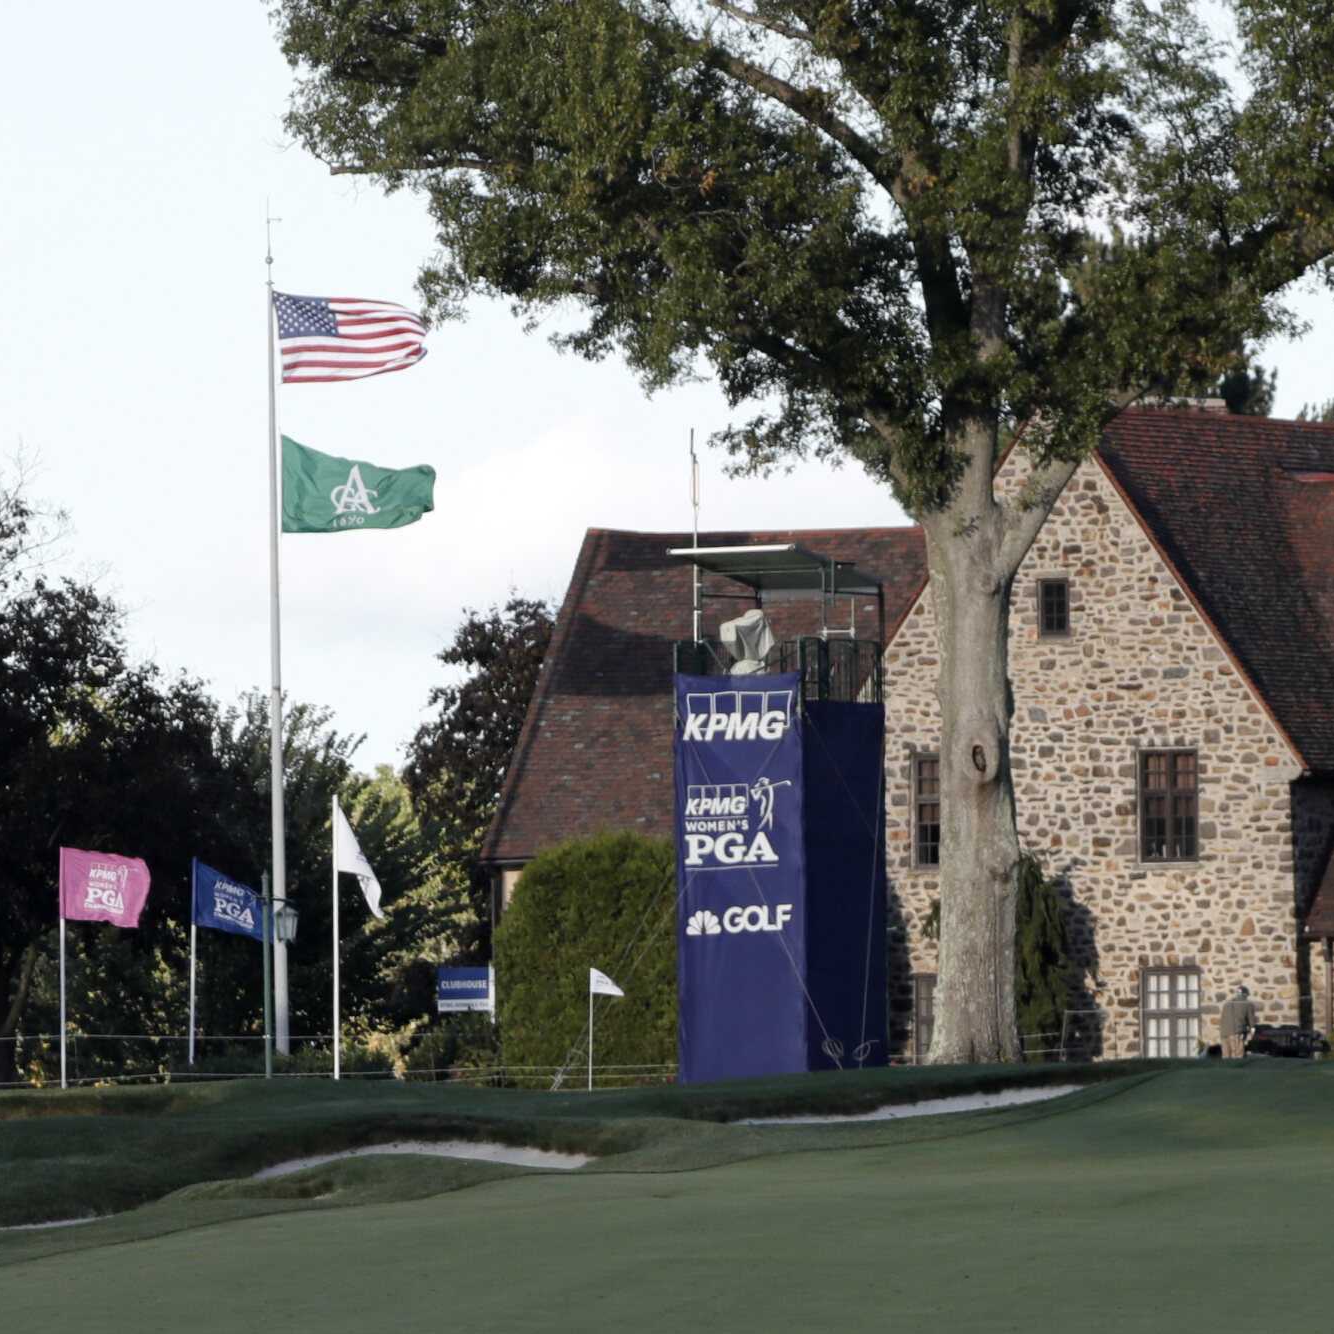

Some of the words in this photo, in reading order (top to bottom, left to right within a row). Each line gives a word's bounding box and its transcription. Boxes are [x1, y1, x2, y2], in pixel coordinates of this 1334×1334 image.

[683, 710, 787, 742] KPMG
[685, 796, 747, 816] KPMG
[685, 819, 749, 832] WOMEN'S
[684, 831, 779, 865] PGA
[84, 886, 124, 910] PGA
[214, 897, 255, 925] PGA
[722, 904, 793, 934] GOLF
[441, 980, 487, 989] CLUBHOUSE
